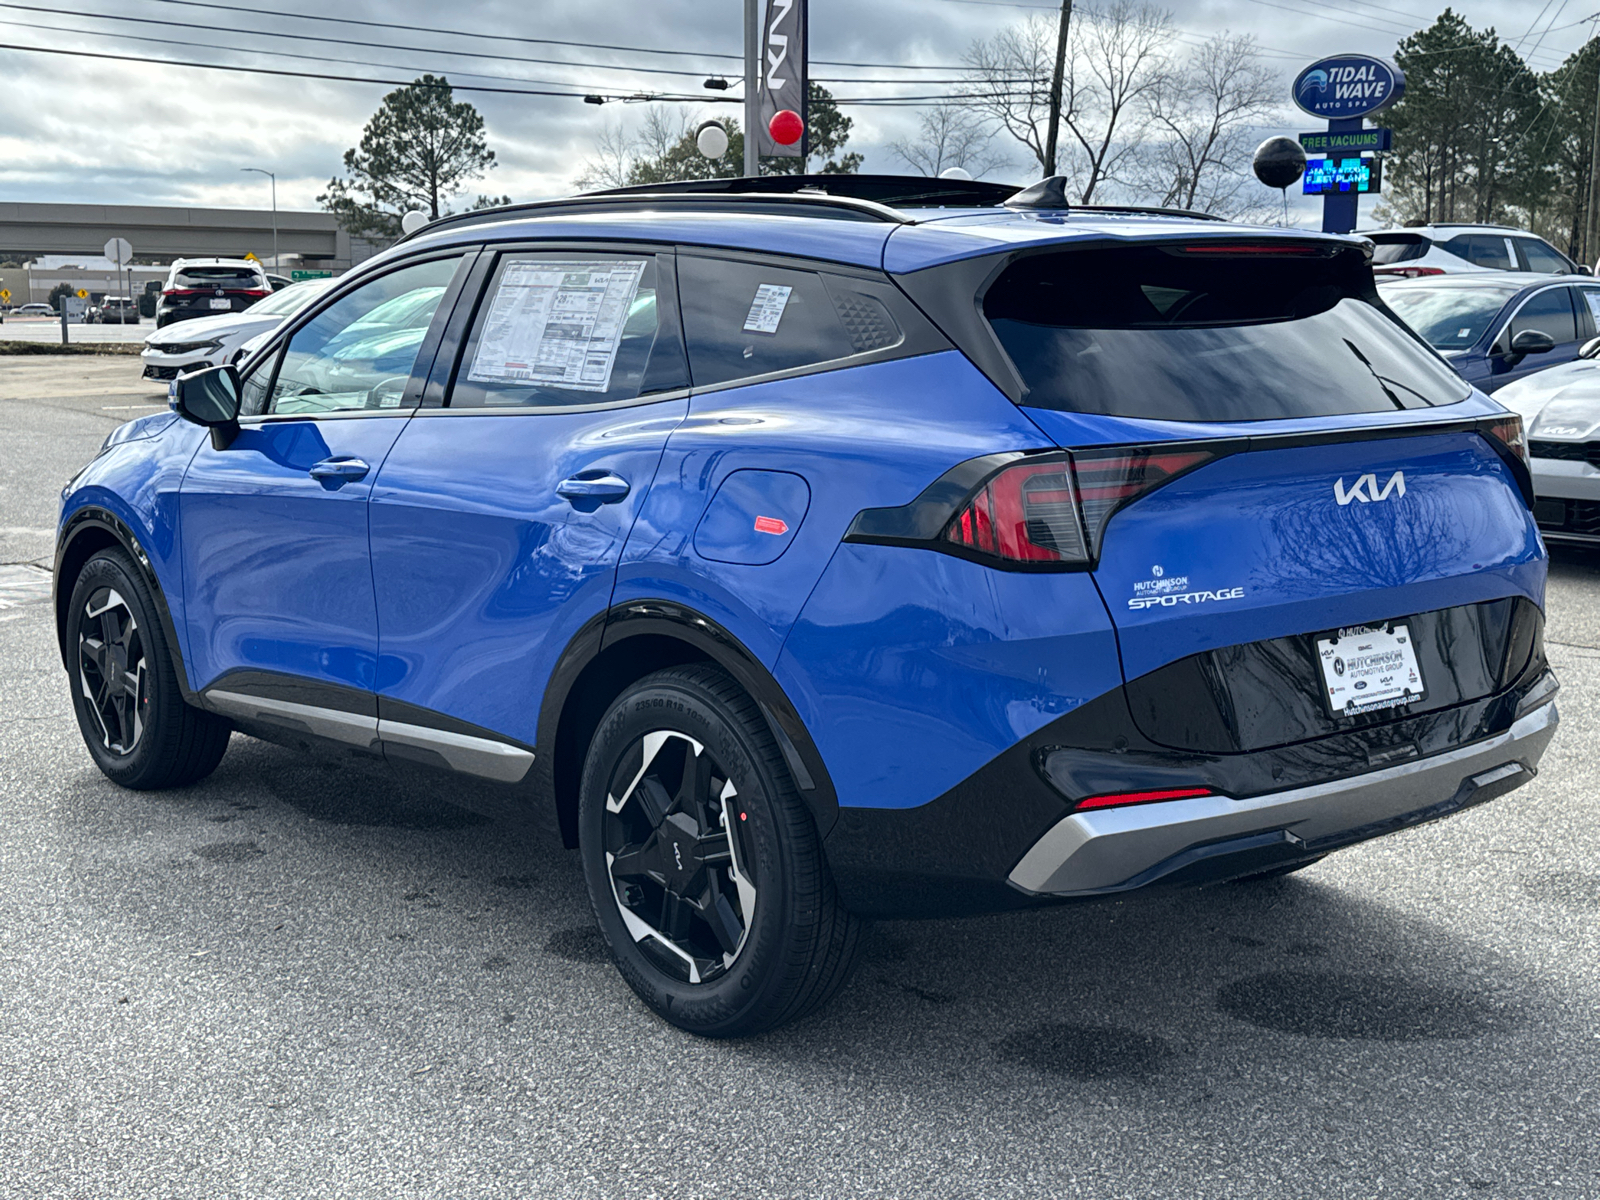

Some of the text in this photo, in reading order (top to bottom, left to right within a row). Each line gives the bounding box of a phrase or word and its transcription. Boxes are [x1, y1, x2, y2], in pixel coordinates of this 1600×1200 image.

[1329, 65, 1376, 83] TIDAL
[1335, 81, 1386, 99] WAVE
[1315, 102, 1341, 110] AUTO
[1302, 133, 1378, 148] FREE VACUUMS
[1334, 470, 1406, 505] KIA
[1133, 576, 1188, 591] HUTCHINSON
[1128, 587, 1245, 610] SPORTAGE
[1321, 649, 1335, 657] KIA
[1358, 644, 1373, 652] GMC
[1350, 662, 1404, 679] AUTOMOTIVE GROUP
[1380, 676, 1394, 684] KIA
[635, 698, 664, 711] 235/60
[666, 700, 685, 712] R18
[108, 761, 137, 778] KUMHO
